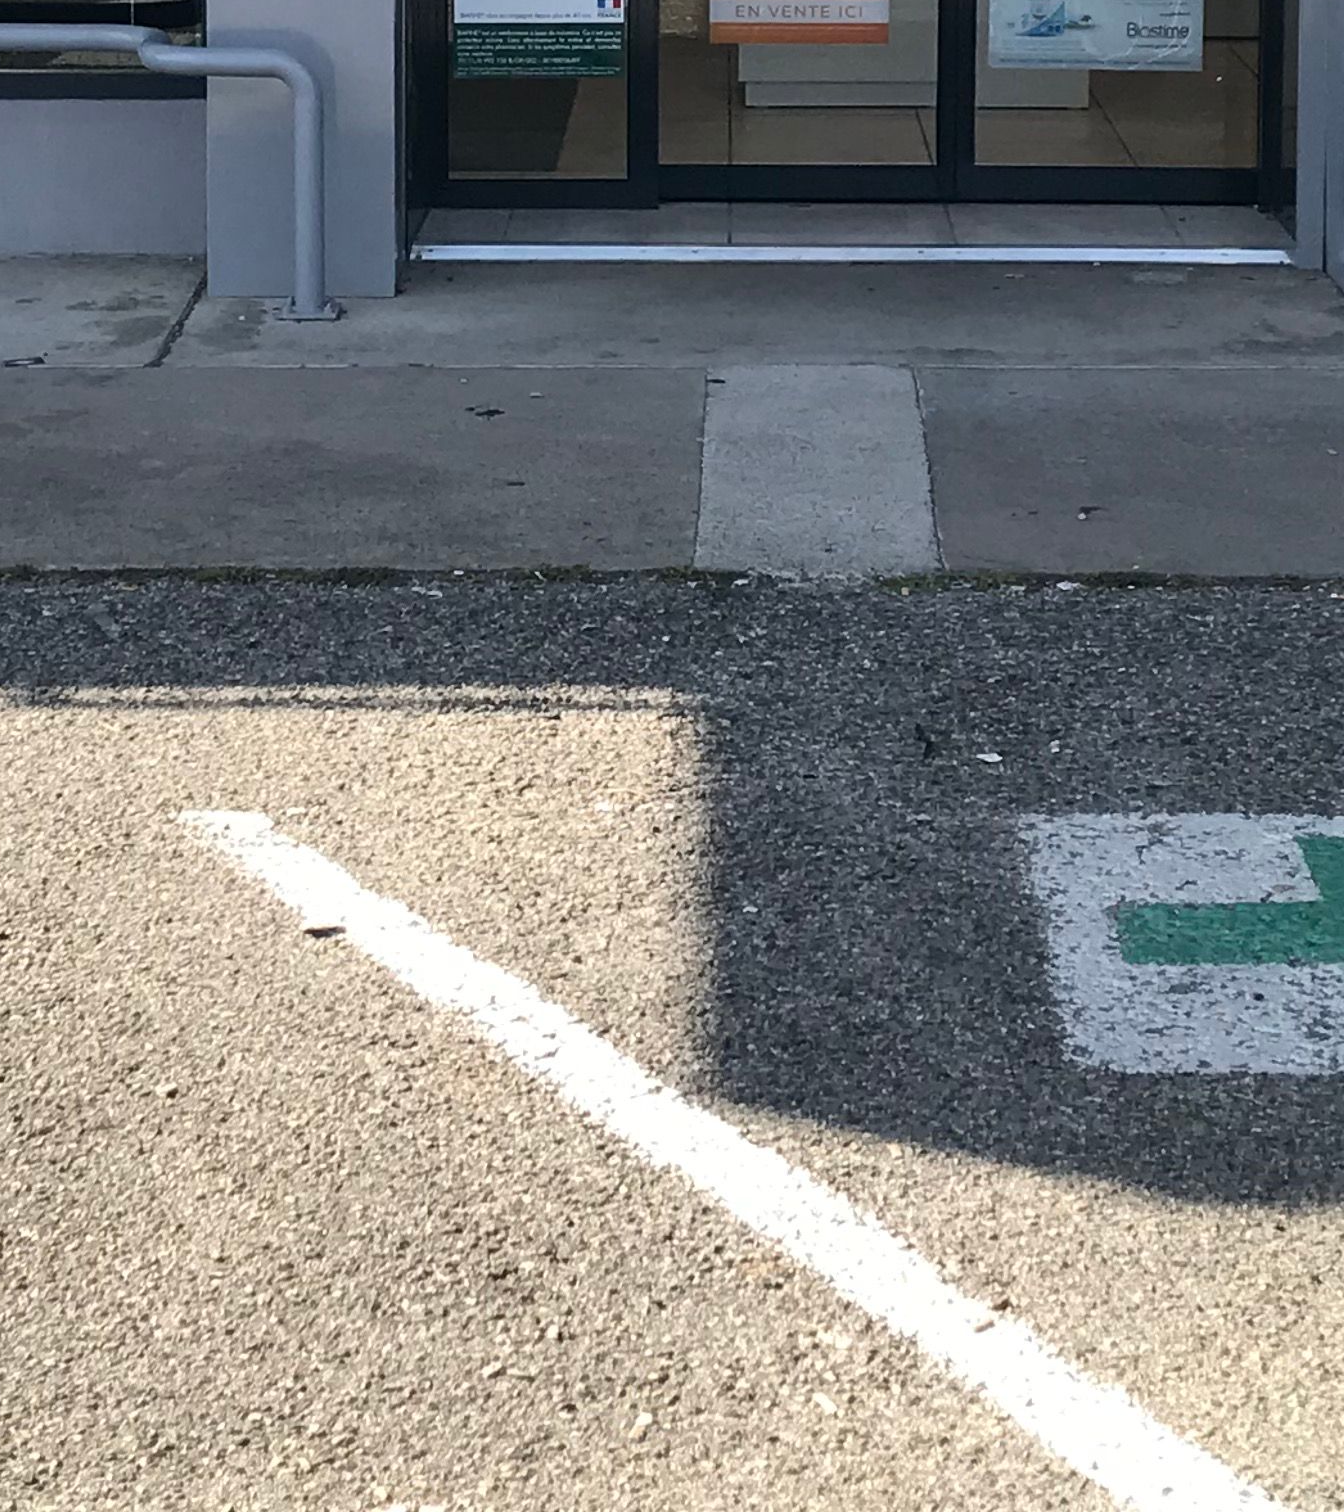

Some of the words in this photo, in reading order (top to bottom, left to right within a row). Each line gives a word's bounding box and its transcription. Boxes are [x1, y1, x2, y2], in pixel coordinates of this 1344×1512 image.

[735, 5, 759, 18] EN
[768, 5, 830, 18] VENTE
[838, 5, 863, 18] ICI
[1126, 23, 1190, 39] Biostime
